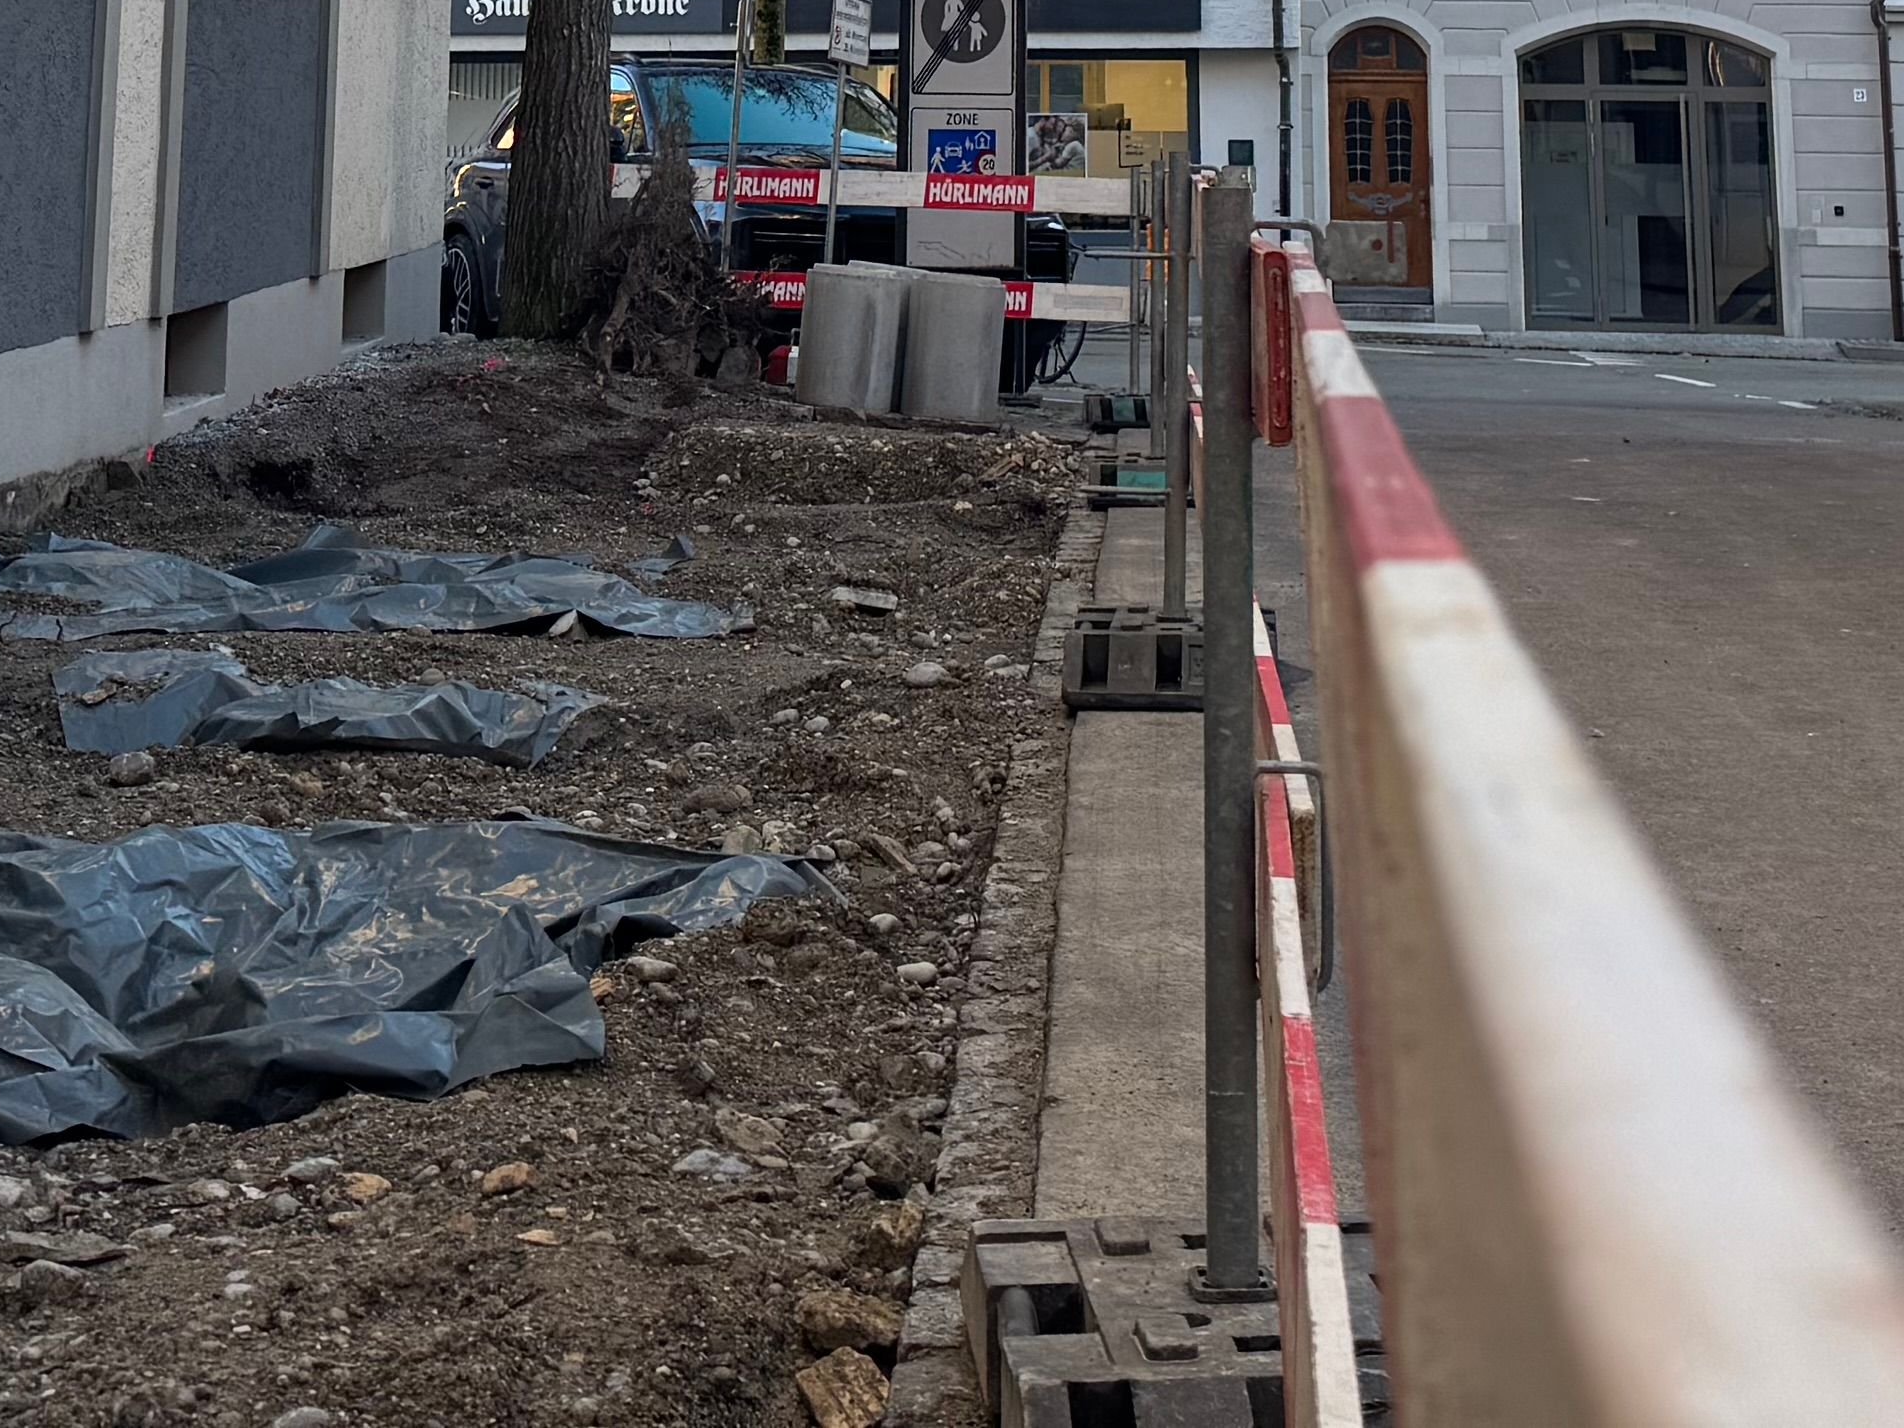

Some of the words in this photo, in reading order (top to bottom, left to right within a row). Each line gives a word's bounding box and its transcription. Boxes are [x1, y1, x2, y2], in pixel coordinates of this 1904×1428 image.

[945, 112, 979, 126] ZONE
[982, 158, 995, 171] 20
[928, 178, 1029, 206] HÜRLIMANN
